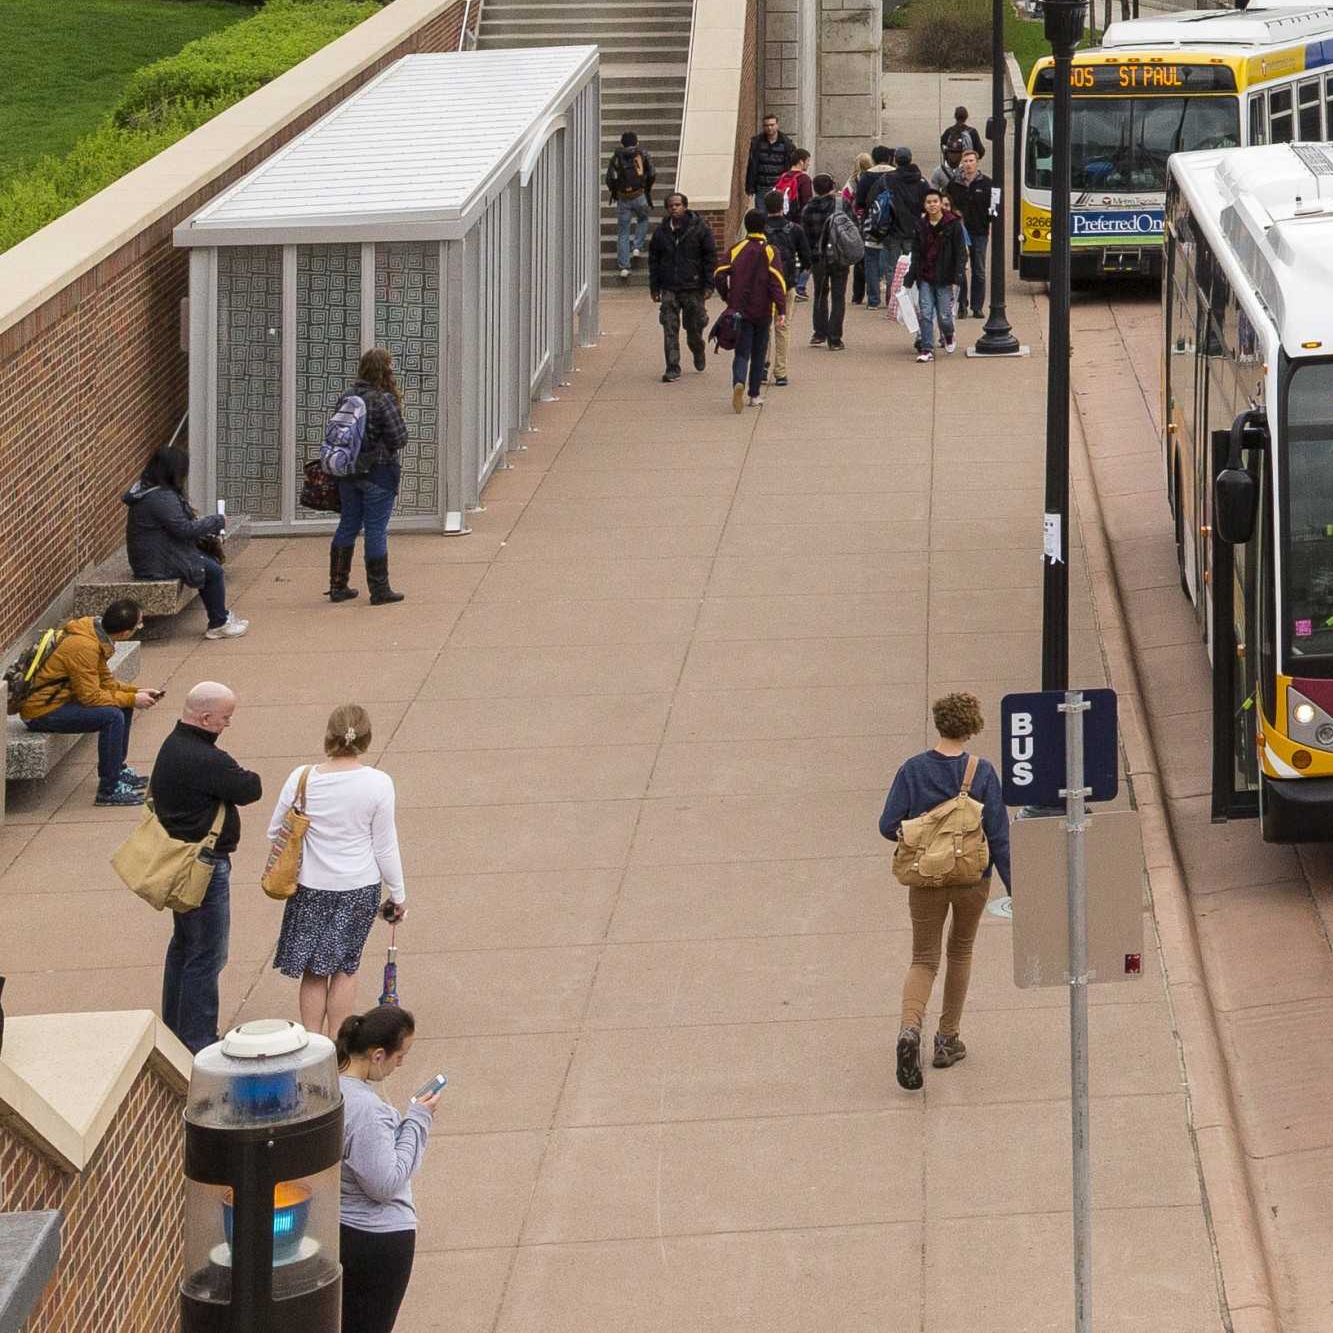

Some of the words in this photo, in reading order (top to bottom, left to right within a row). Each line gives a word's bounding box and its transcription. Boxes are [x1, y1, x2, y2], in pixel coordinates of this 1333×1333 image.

[1119, 65, 1137, 88] ST
[1143, 65, 1183, 87] PAUL
[1026, 216, 1052, 228] 3266
[1010, 712, 1034, 786] BUS
